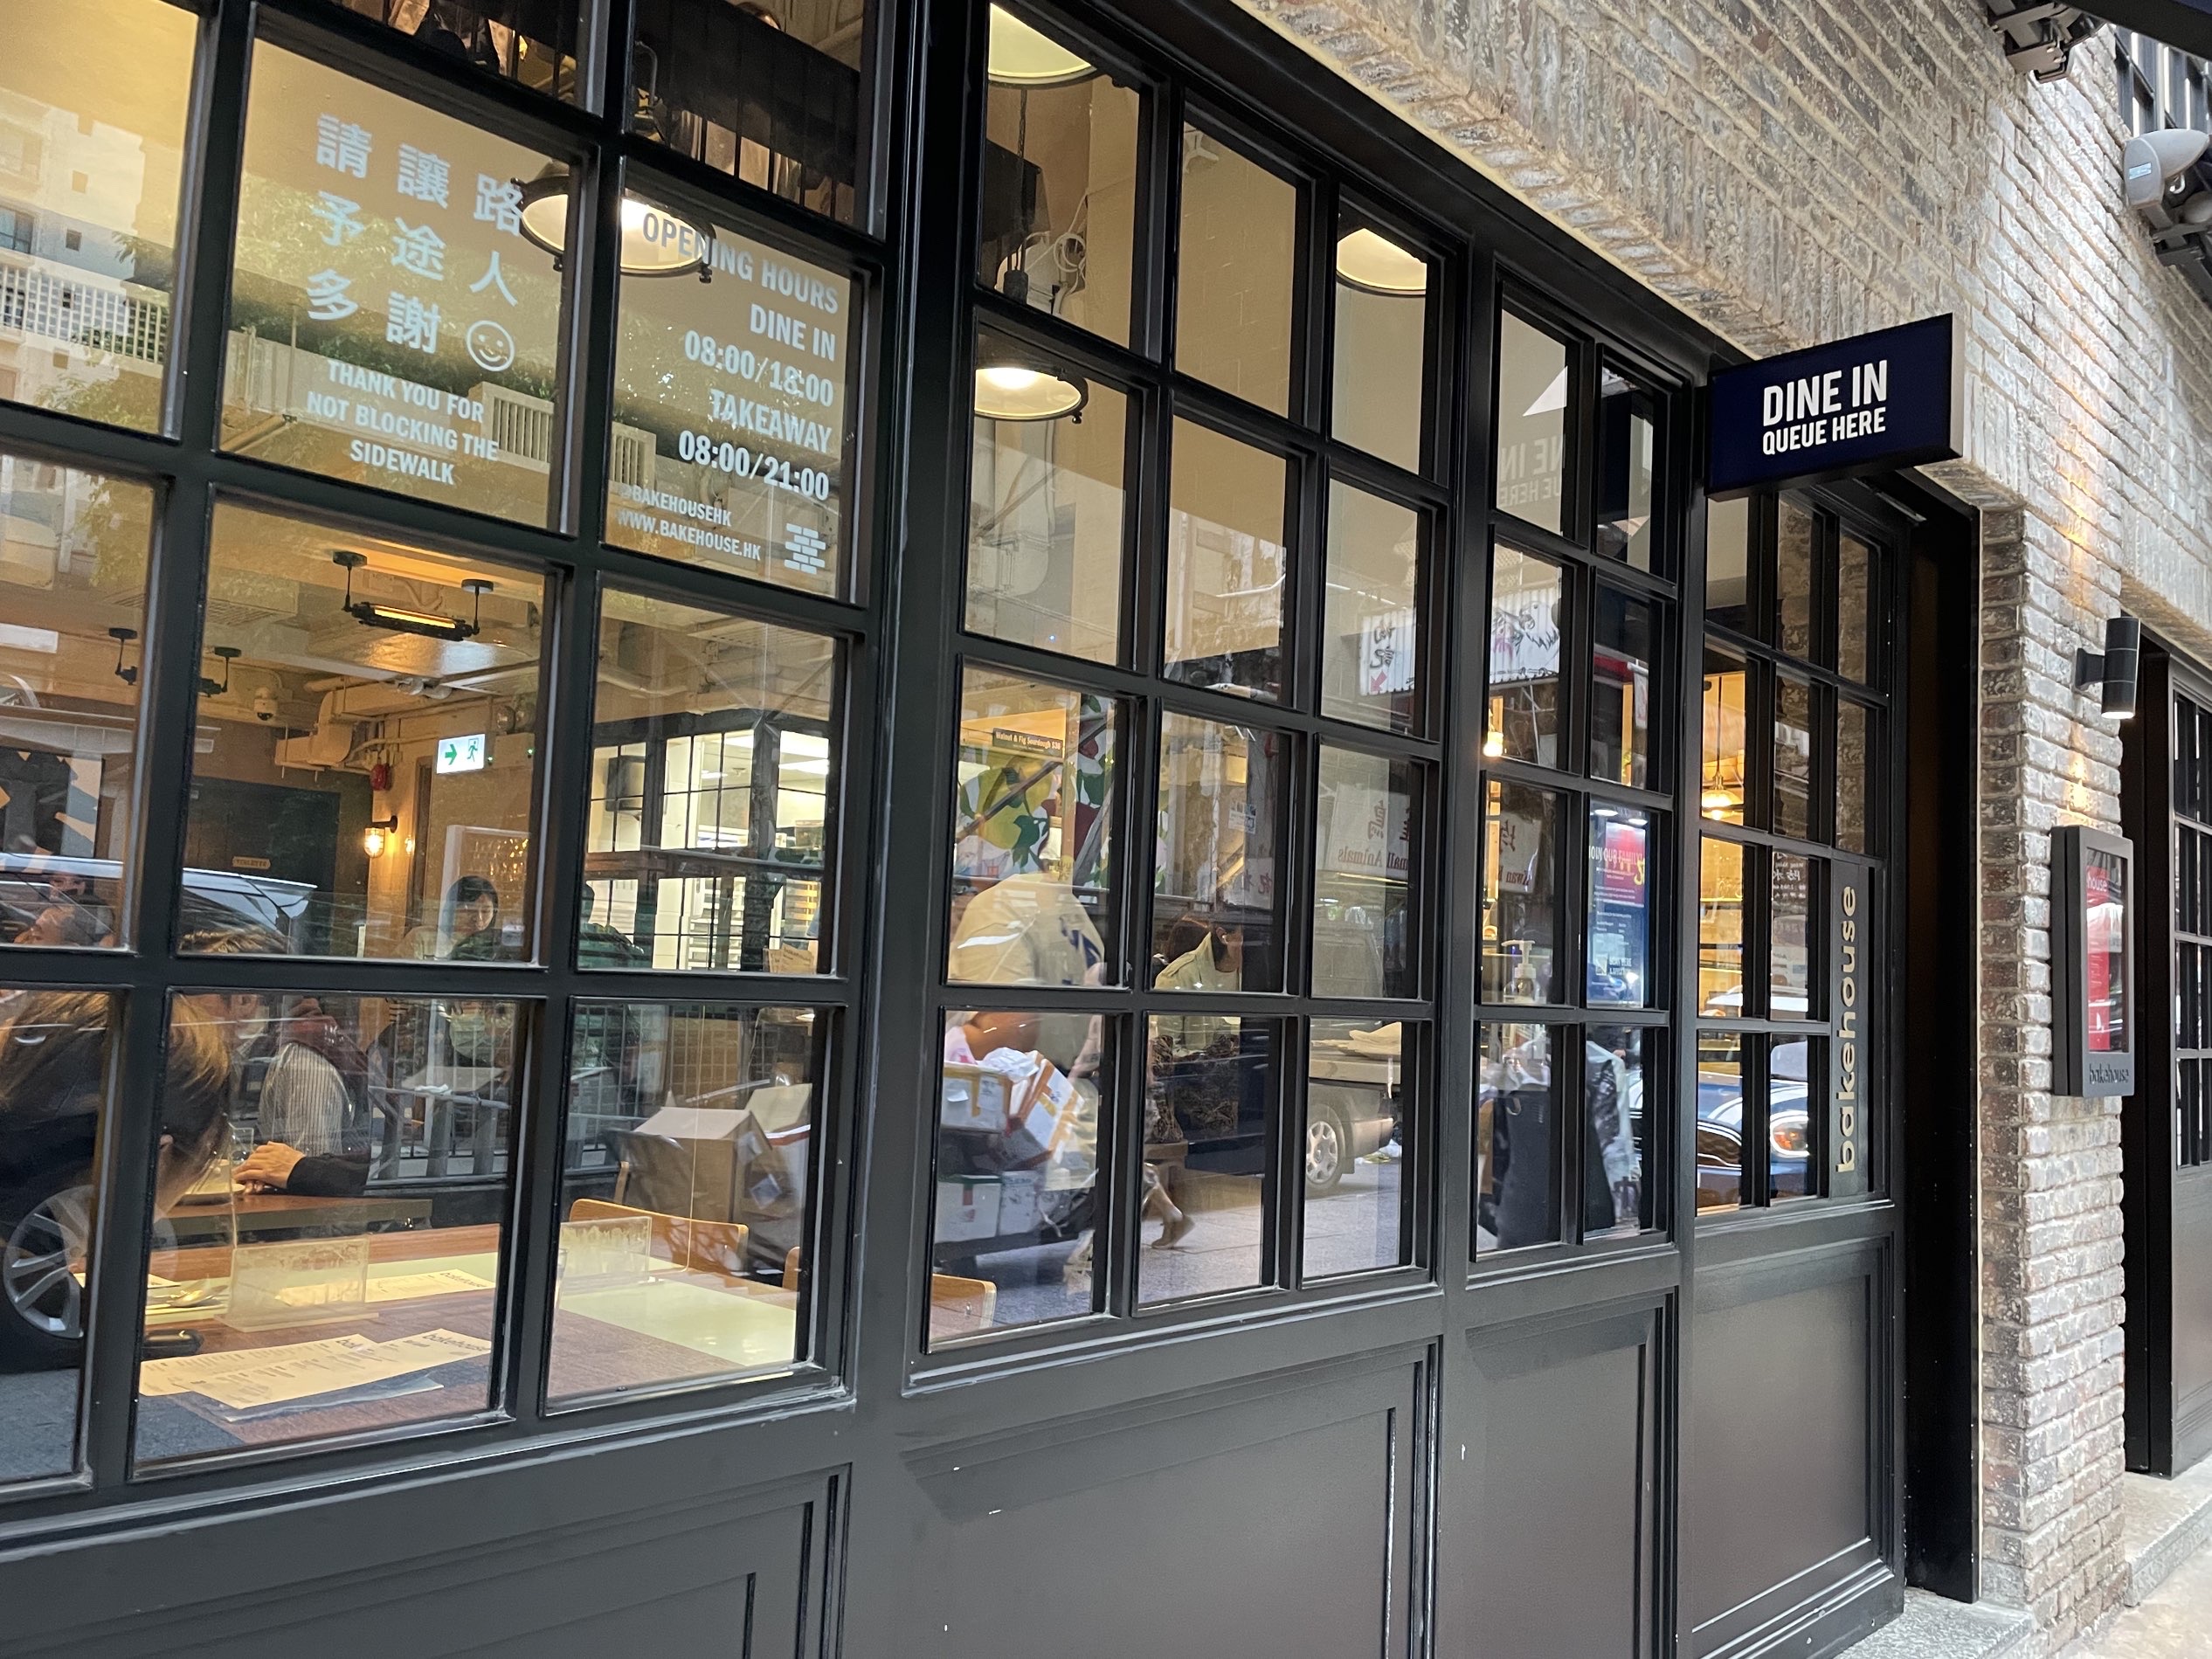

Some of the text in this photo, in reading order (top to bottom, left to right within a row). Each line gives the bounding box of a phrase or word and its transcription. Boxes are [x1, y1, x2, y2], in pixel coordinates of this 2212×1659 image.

[315, 112, 524, 237] 請讓路
[311, 190, 518, 307] 予途人
[642, 211, 839, 315] OPENING HOURS
[307, 268, 441, 354] 多謝
[750, 302, 836, 362] DINE IN
[327, 359, 485, 424] THANK YOU FOR
[684, 329, 834, 408] 08:00/18:00
[1762, 359, 1888, 427] DINE IN
[307, 391, 499, 461] NOT BLOCKING THE
[710, 388, 833, 454] TAKEAWAY
[1762, 406, 1887, 456] QUEUE HERE
[349, 439, 455, 486] SIDEWALK
[678, 429, 830, 501] 08:00/21:00
[617, 509, 762, 561] WWW.BAKEHOUSE.HK
[1835, 885, 1856, 1172] bakehouse
[2089, 1062, 2129, 1084] bakehouse
